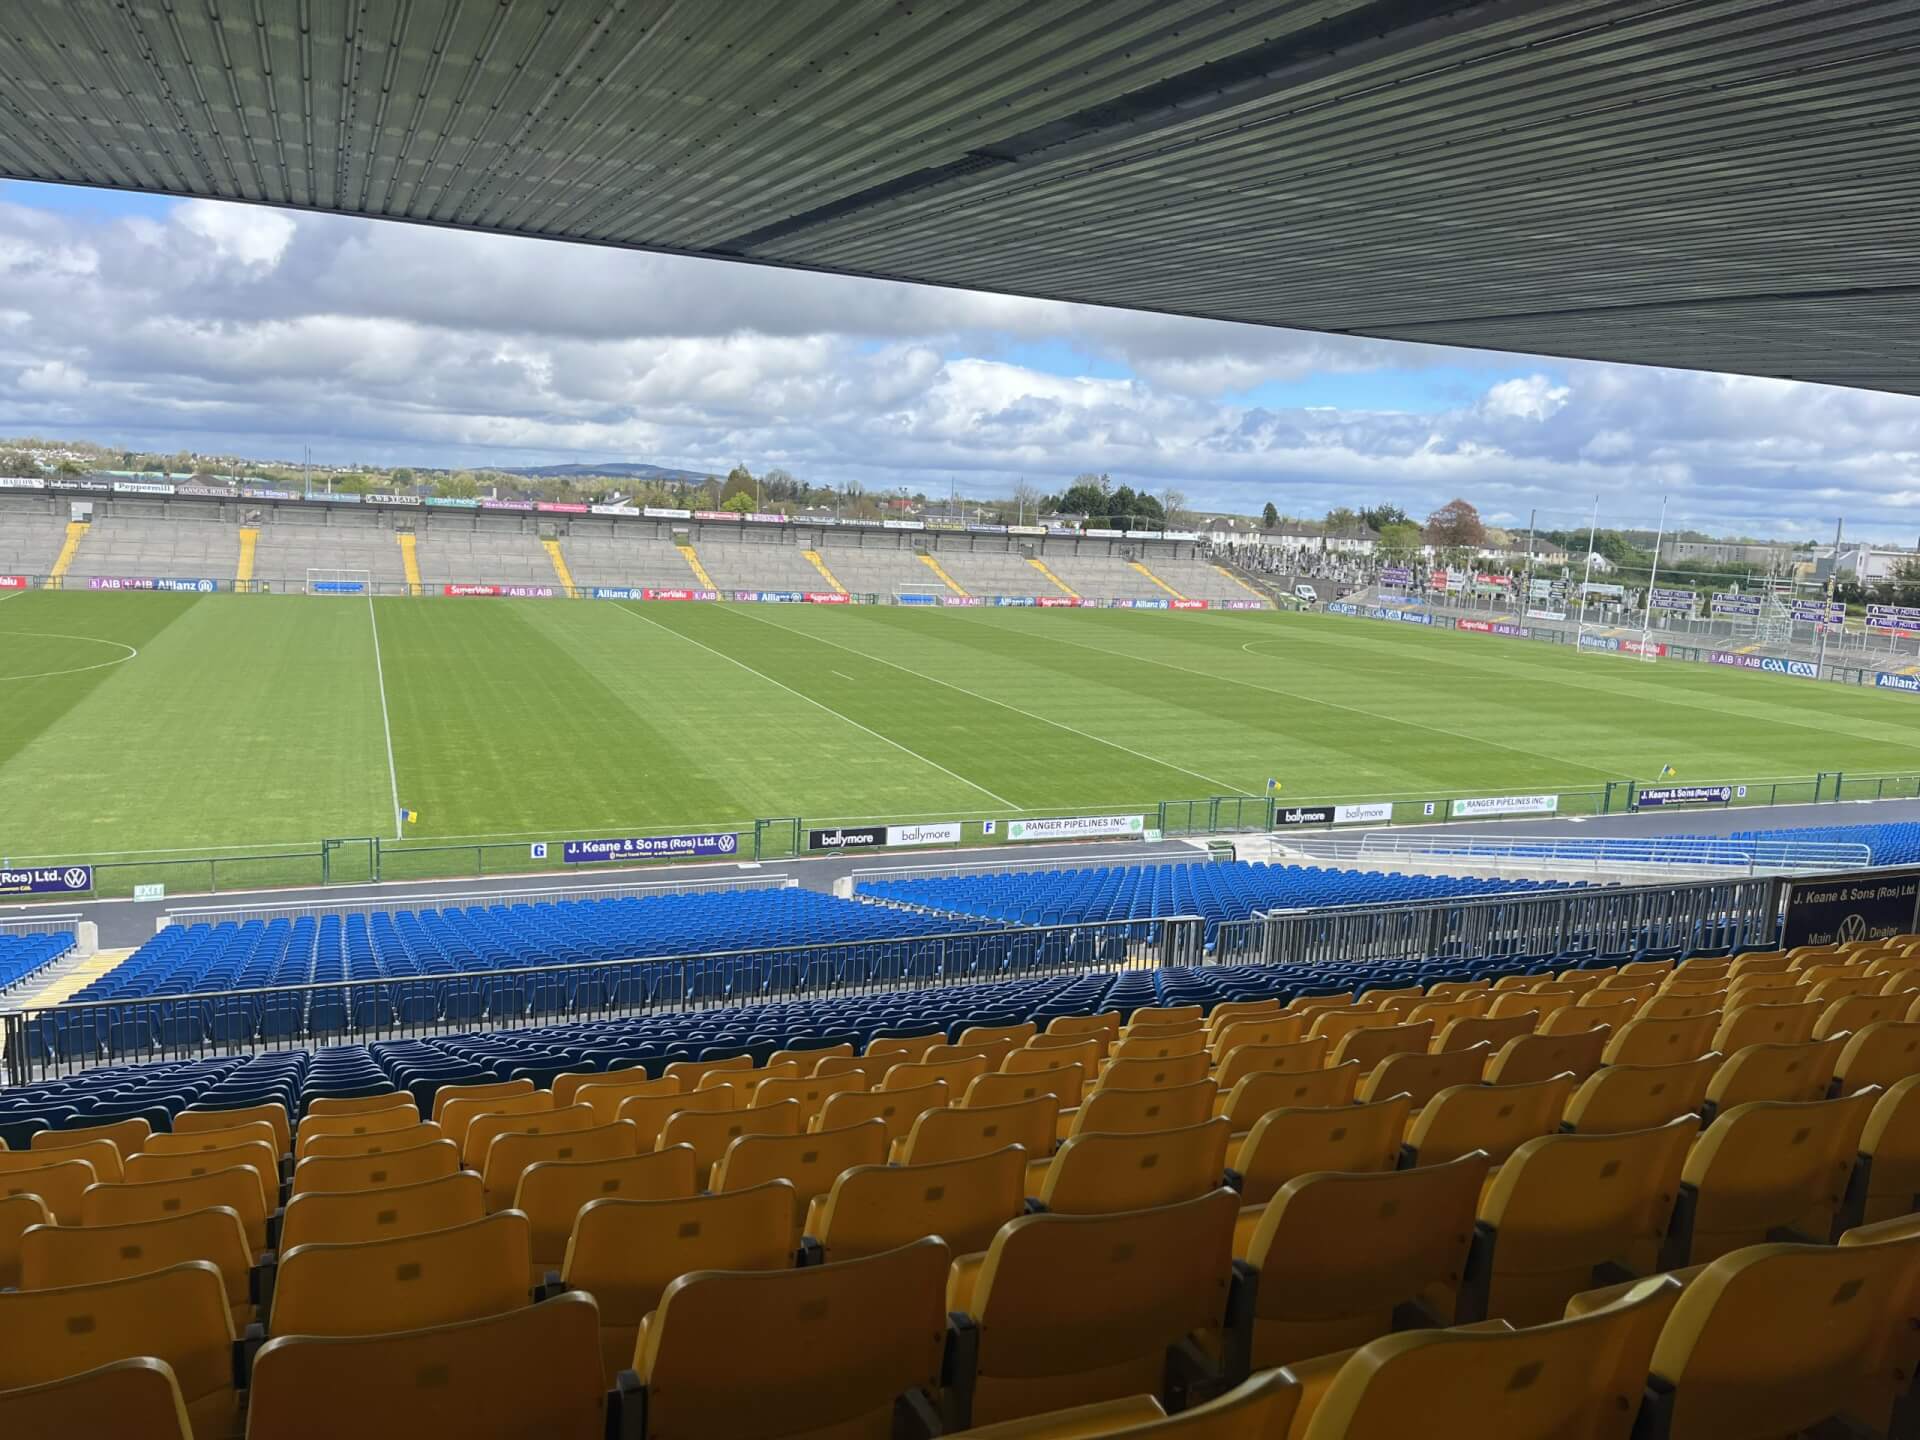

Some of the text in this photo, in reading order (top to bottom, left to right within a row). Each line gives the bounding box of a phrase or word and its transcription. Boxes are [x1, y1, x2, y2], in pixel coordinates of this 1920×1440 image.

[118, 482, 171, 493] Peppermill
[0, 577, 17, 586] alu
[101, 579, 121, 588] AIB
[134, 580, 153, 589] AIB
[157, 579, 197, 591] Allianz
[509, 587, 526, 596] AIB
[536, 588, 553, 597] AIB
[596, 589, 629, 599] Allianz
[701, 591, 716, 600] AIB
[743, 593, 758, 601] AIB
[947, 597, 960, 605] AIB
[1120, 600, 1133, 608] AIB
[1134, 600, 1159, 609] Allianz
[1402, 612, 1423, 623] Allianz
[1498, 624, 1511, 633] AIB
[1580, 635, 1606, 648] Allianz
[1718, 653, 1734, 664] AIB
[1744, 656, 1761, 667] AIB
[1879, 674, 1919, 690] Allianz
[1738, 787, 1745, 796] D
[1467, 799, 1495, 808] RANGER
[1496, 798, 1531, 807] PIPELINES
[1345, 806, 1384, 820] ballymore
[1426, 804, 1433, 814] E
[1285, 808, 1326, 824] ballymore
[985, 823, 993, 833] F
[1025, 820, 1063, 831] RANGER
[1064, 818, 1109, 829] PIPELINES
[821, 830, 875, 848] ballymore
[901, 827, 951, 842] ballymore
[568, 836, 717, 854] J. Keane & Sons (Ros) Ltd.
[533, 844, 545, 857] G
[0, 870, 62, 886] Ros) Ltd.
[136, 886, 162, 896] EXIT
[1793, 885, 1916, 905] J. Keane & Sons (Ros) Ltd.
[1808, 926, 1898, 944] Main Dealer
